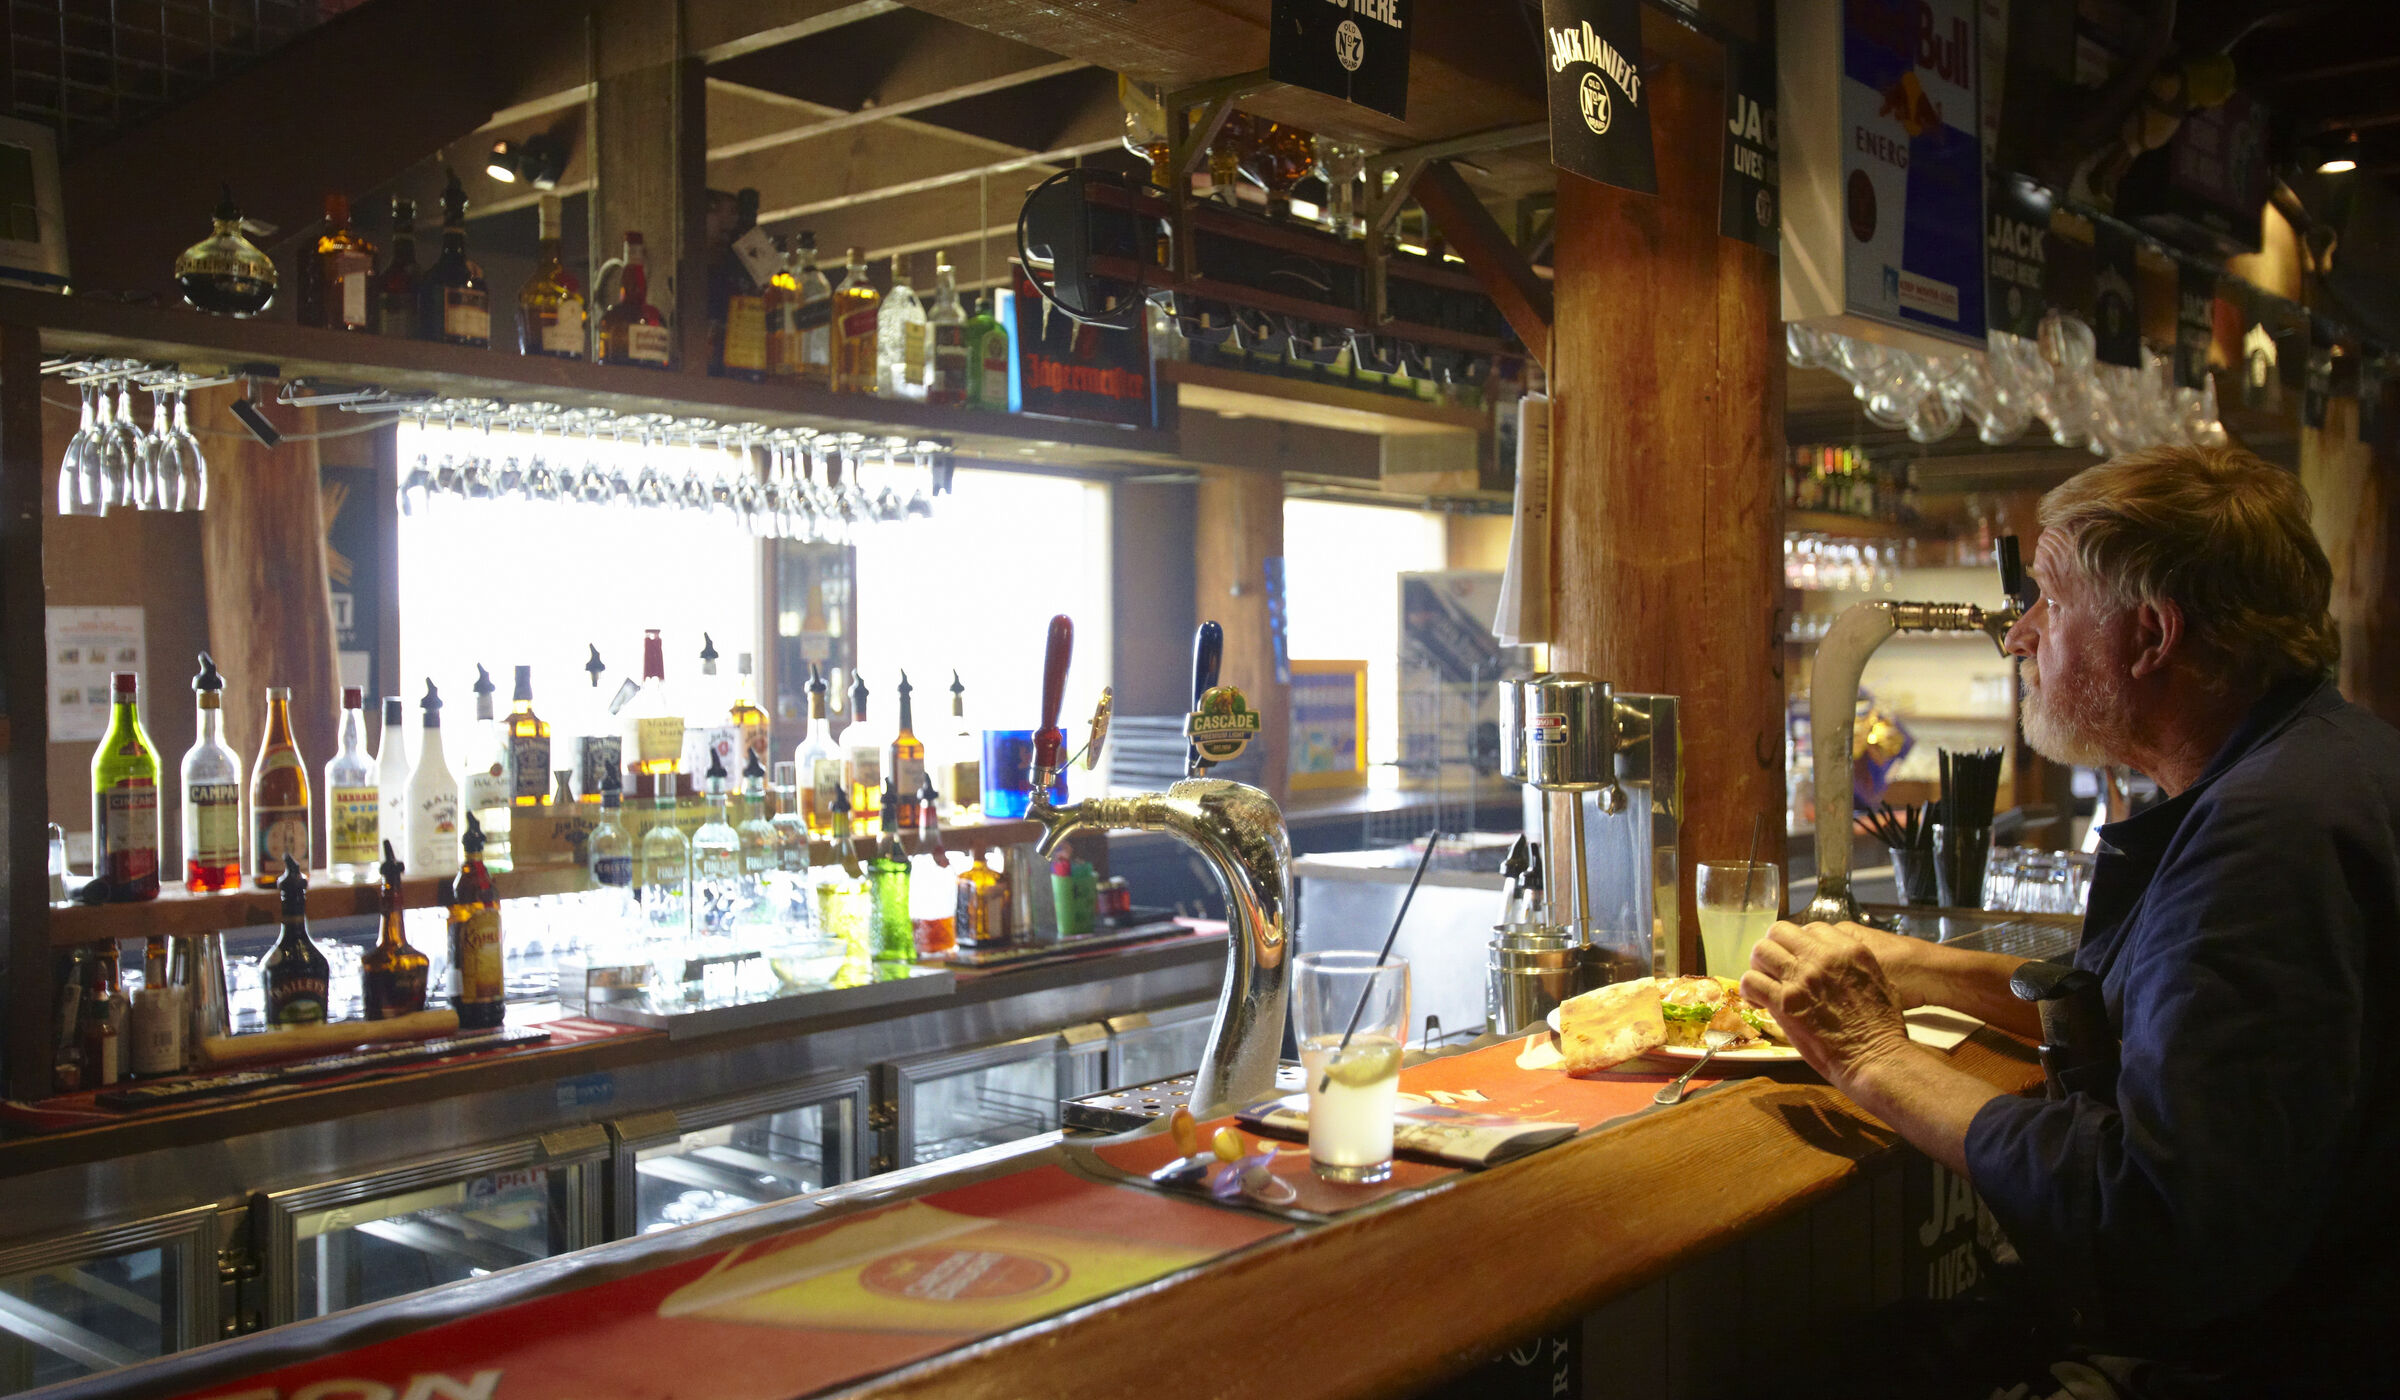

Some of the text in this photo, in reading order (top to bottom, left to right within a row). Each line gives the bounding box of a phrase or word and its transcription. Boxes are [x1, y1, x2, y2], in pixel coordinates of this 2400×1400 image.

[1343, 23, 1356, 34] OLD
[1548, 26, 1584, 72] JACK
[1588, 79, 1601, 91] OLD
[1734, 143, 1764, 181] LIVES
[1989, 213, 2046, 263] JACK
[1193, 714, 1254, 732] CASCADE
